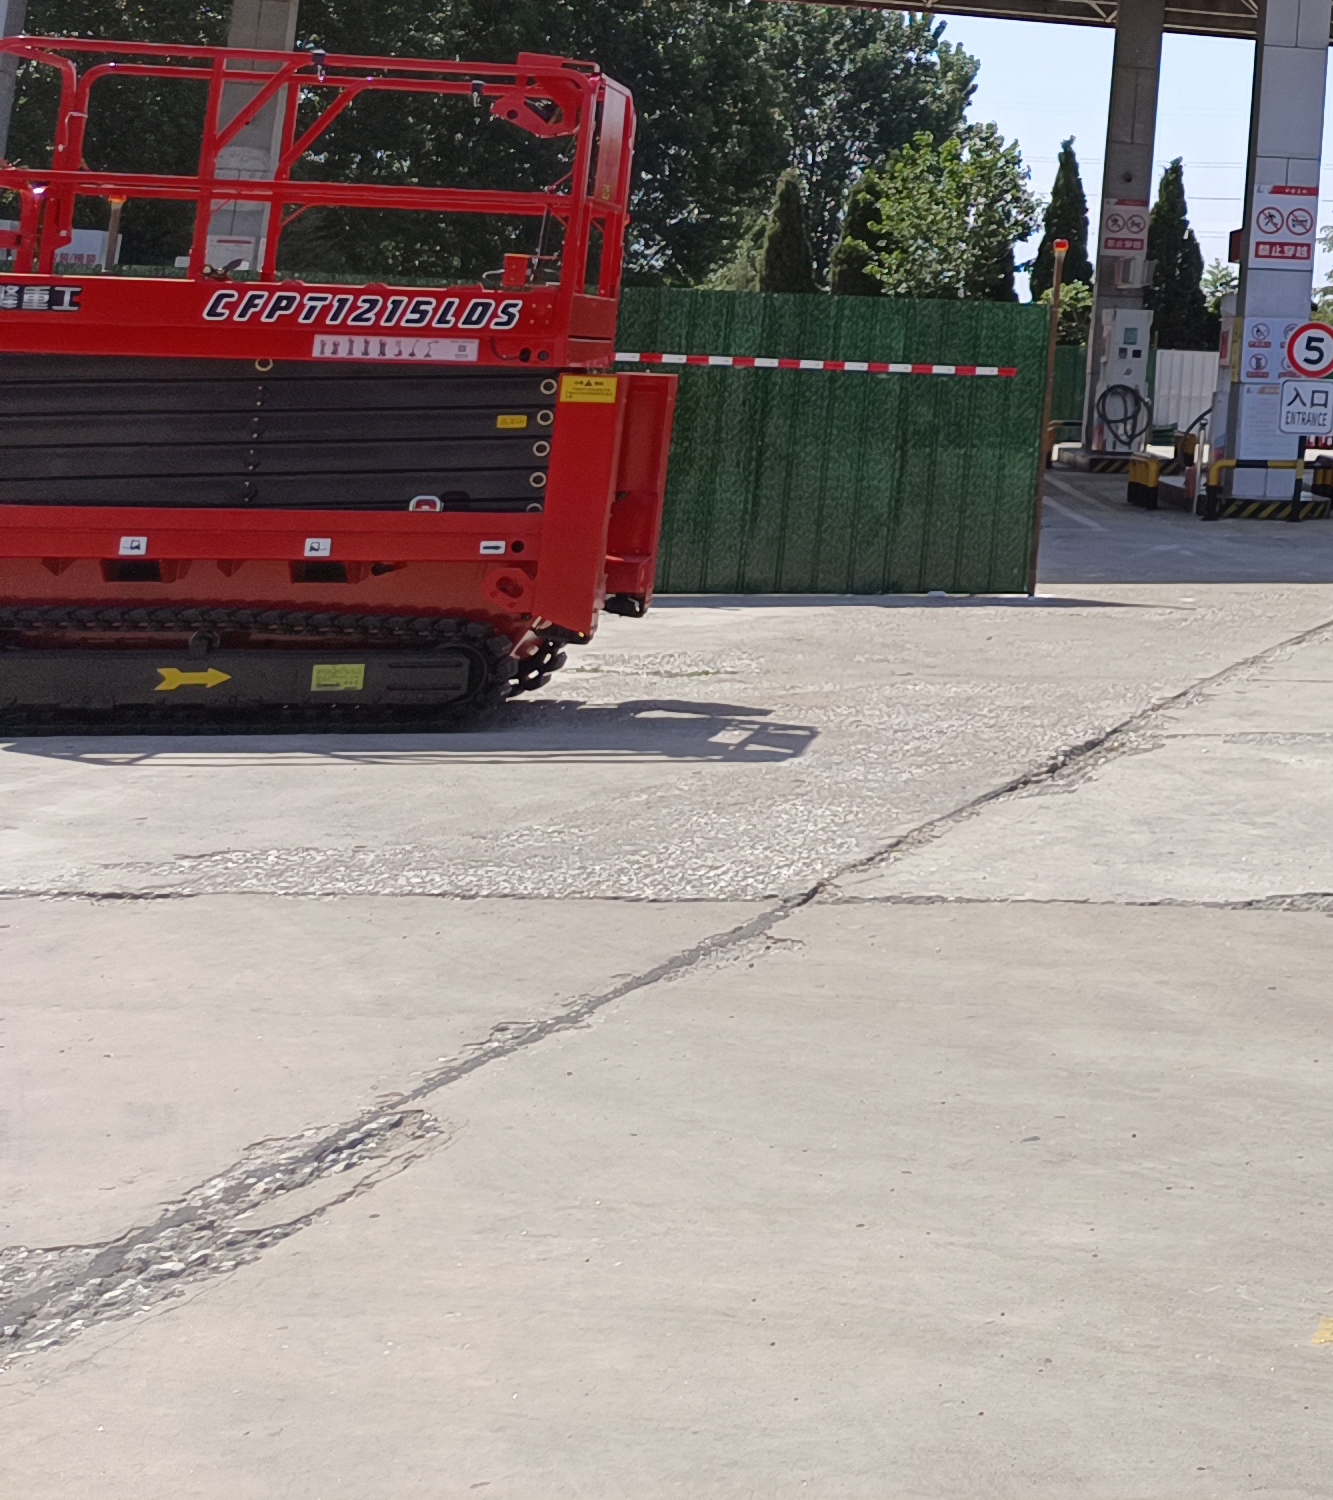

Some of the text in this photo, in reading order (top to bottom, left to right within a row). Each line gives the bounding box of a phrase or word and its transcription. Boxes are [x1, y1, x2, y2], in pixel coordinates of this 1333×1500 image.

[203, 290, 522, 330] CFPT1215LDS
[1303, 336, 1325, 365] 5
[1287, 387, 1329, 409] 入口
[1285, 411, 1328, 427] ENTRANCE
